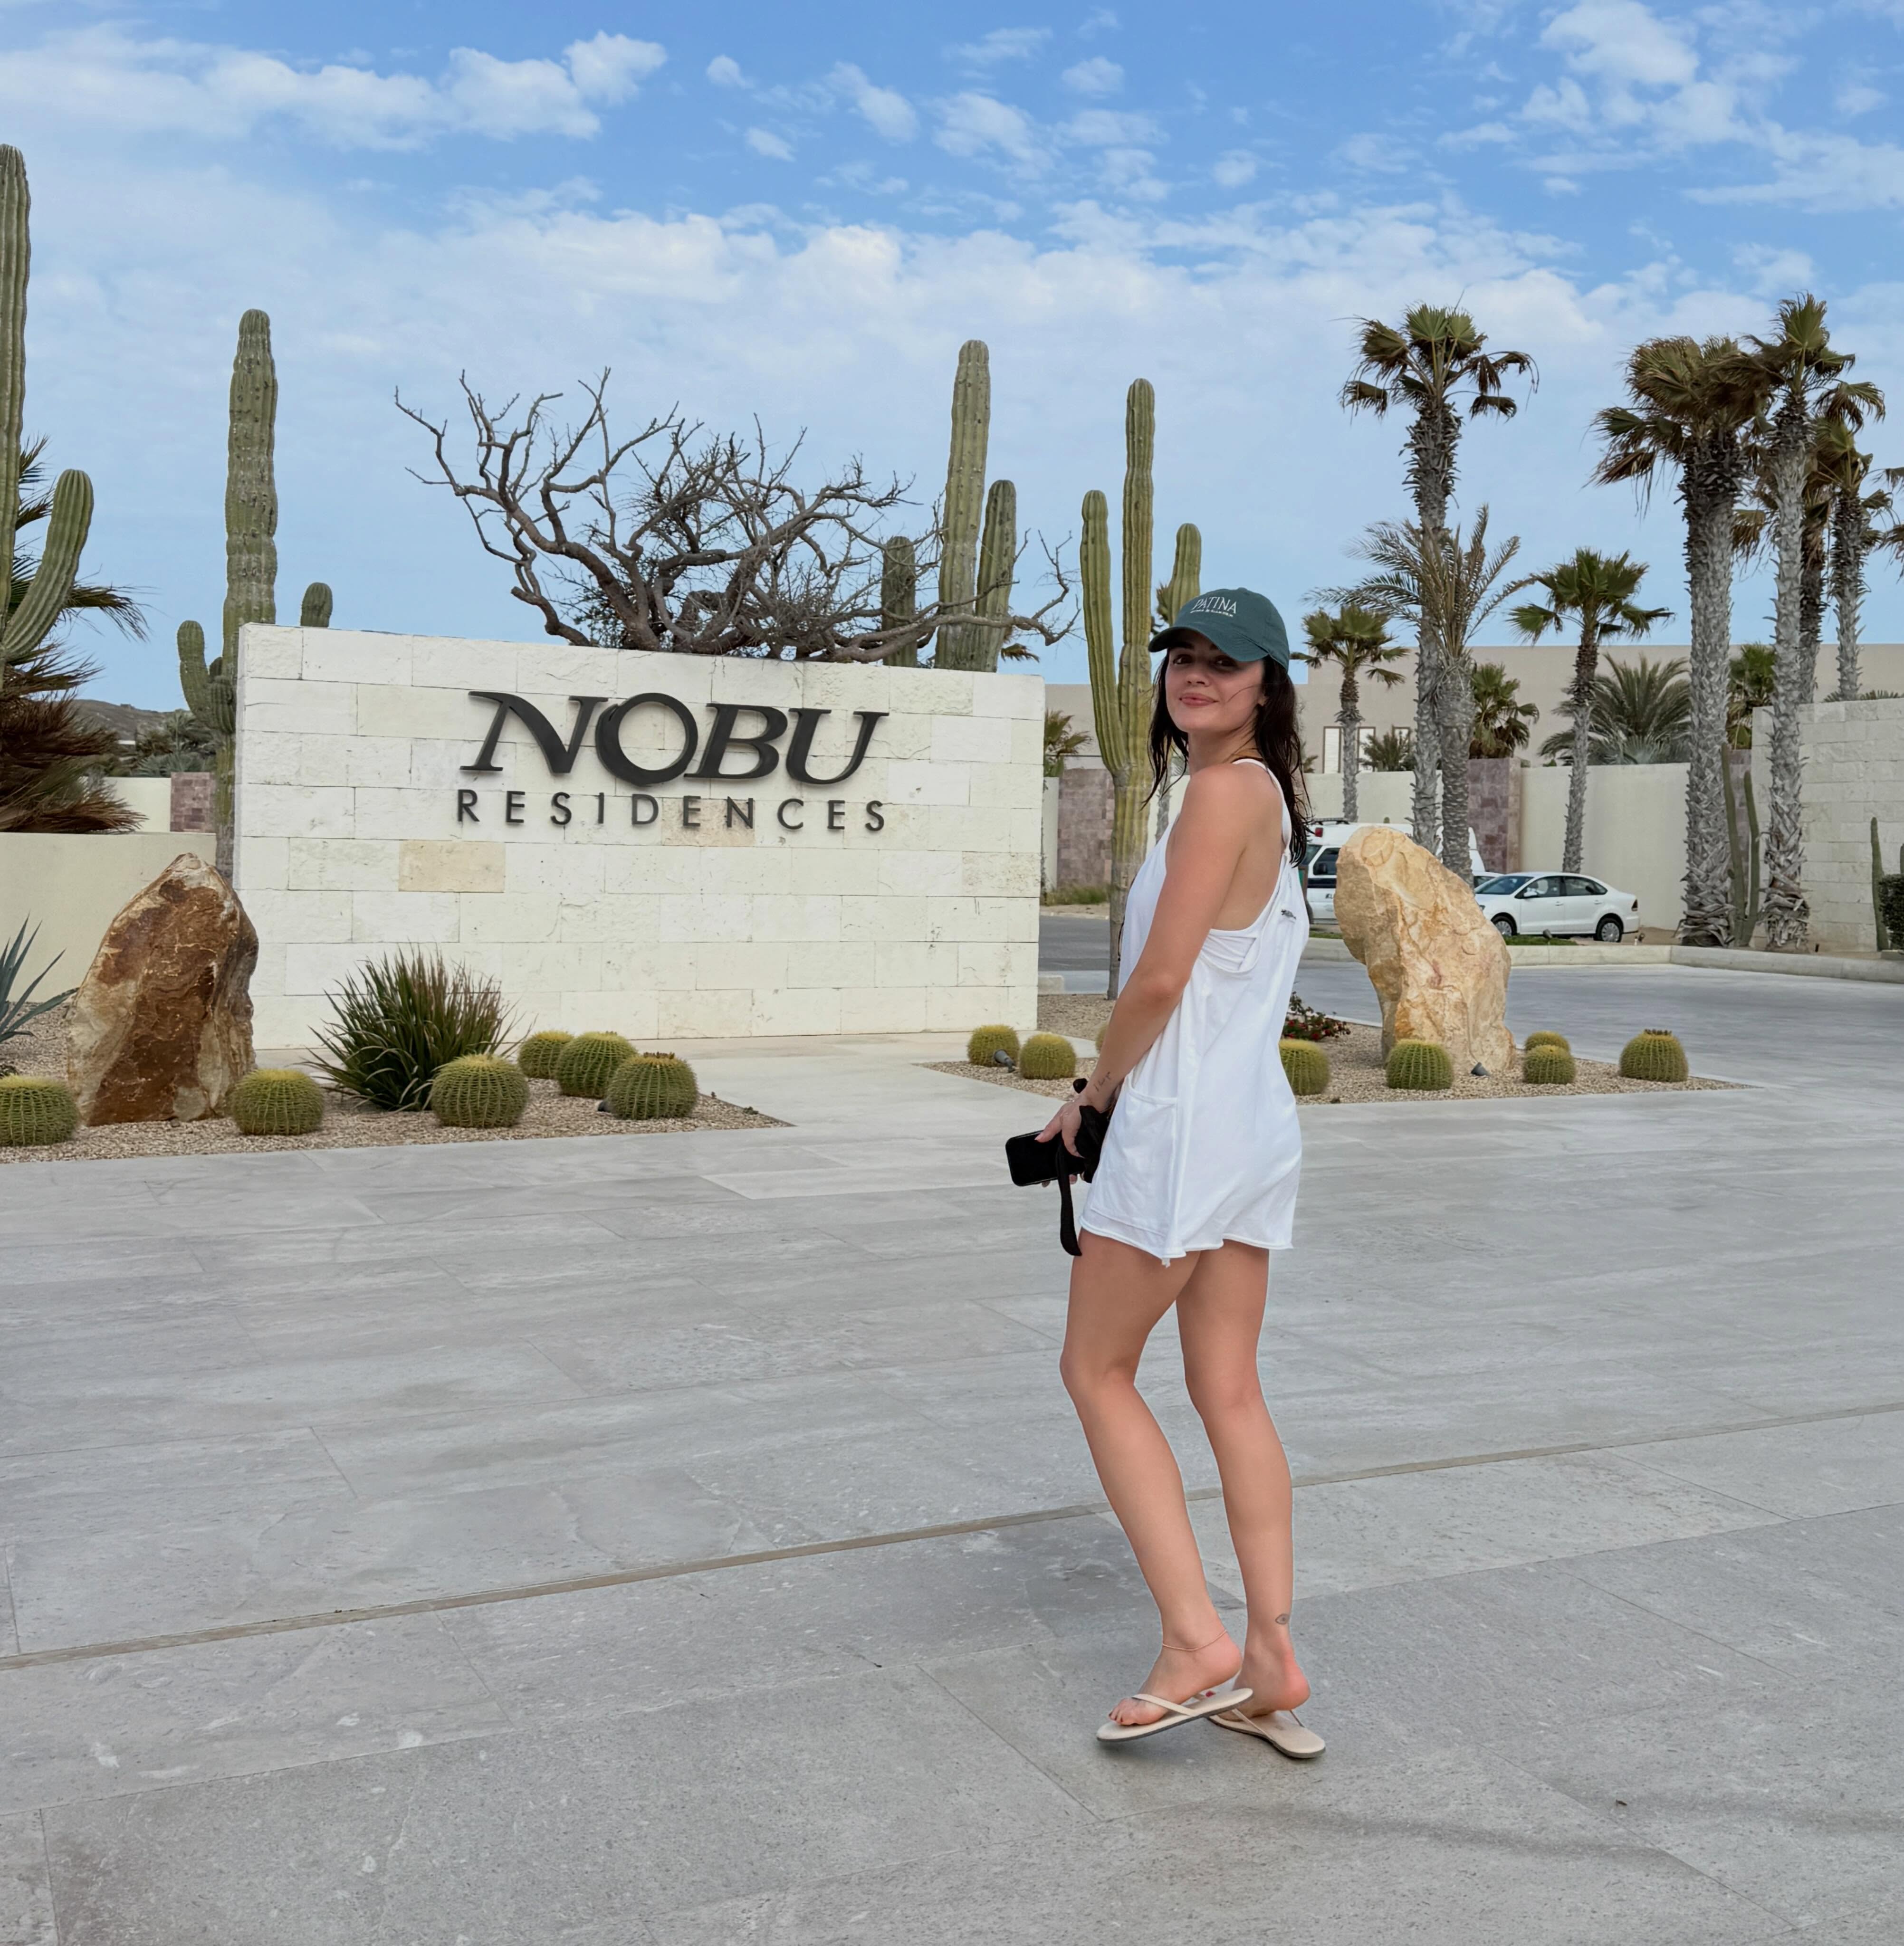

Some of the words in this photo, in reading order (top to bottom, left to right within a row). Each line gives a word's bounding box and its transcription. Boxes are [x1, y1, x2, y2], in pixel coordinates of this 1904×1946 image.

[1191, 596, 1236, 613] PATINA
[460, 691, 890, 786] NOBU
[458, 789, 884, 831] RESIDENCES
